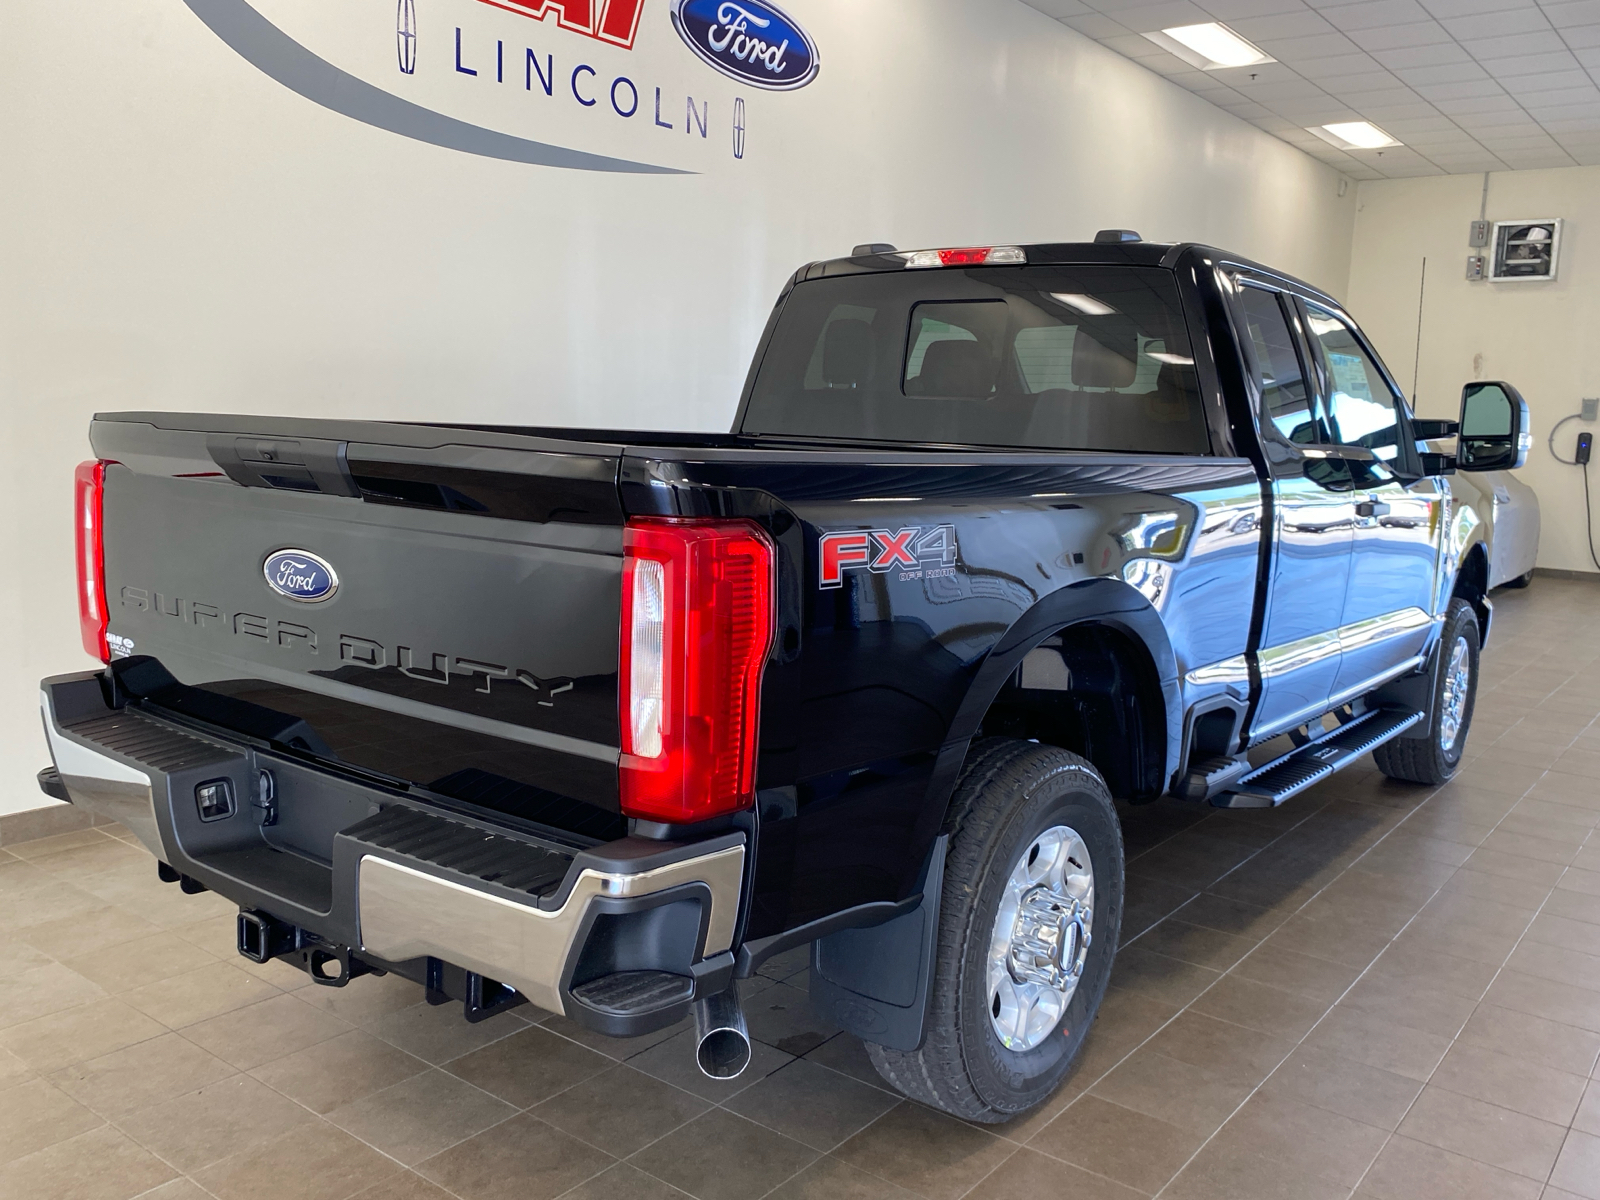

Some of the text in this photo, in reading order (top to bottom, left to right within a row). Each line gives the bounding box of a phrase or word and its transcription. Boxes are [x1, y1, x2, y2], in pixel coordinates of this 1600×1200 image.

[708, 1, 789, 74] Ford
[454, 27, 709, 139] LINCOLN
[276, 559, 317, 592] Ford
[819, 524, 957, 590] FX4
[899, 568, 956, 582] OFF ROAD
[121, 586, 575, 708] SUPER DUTY
